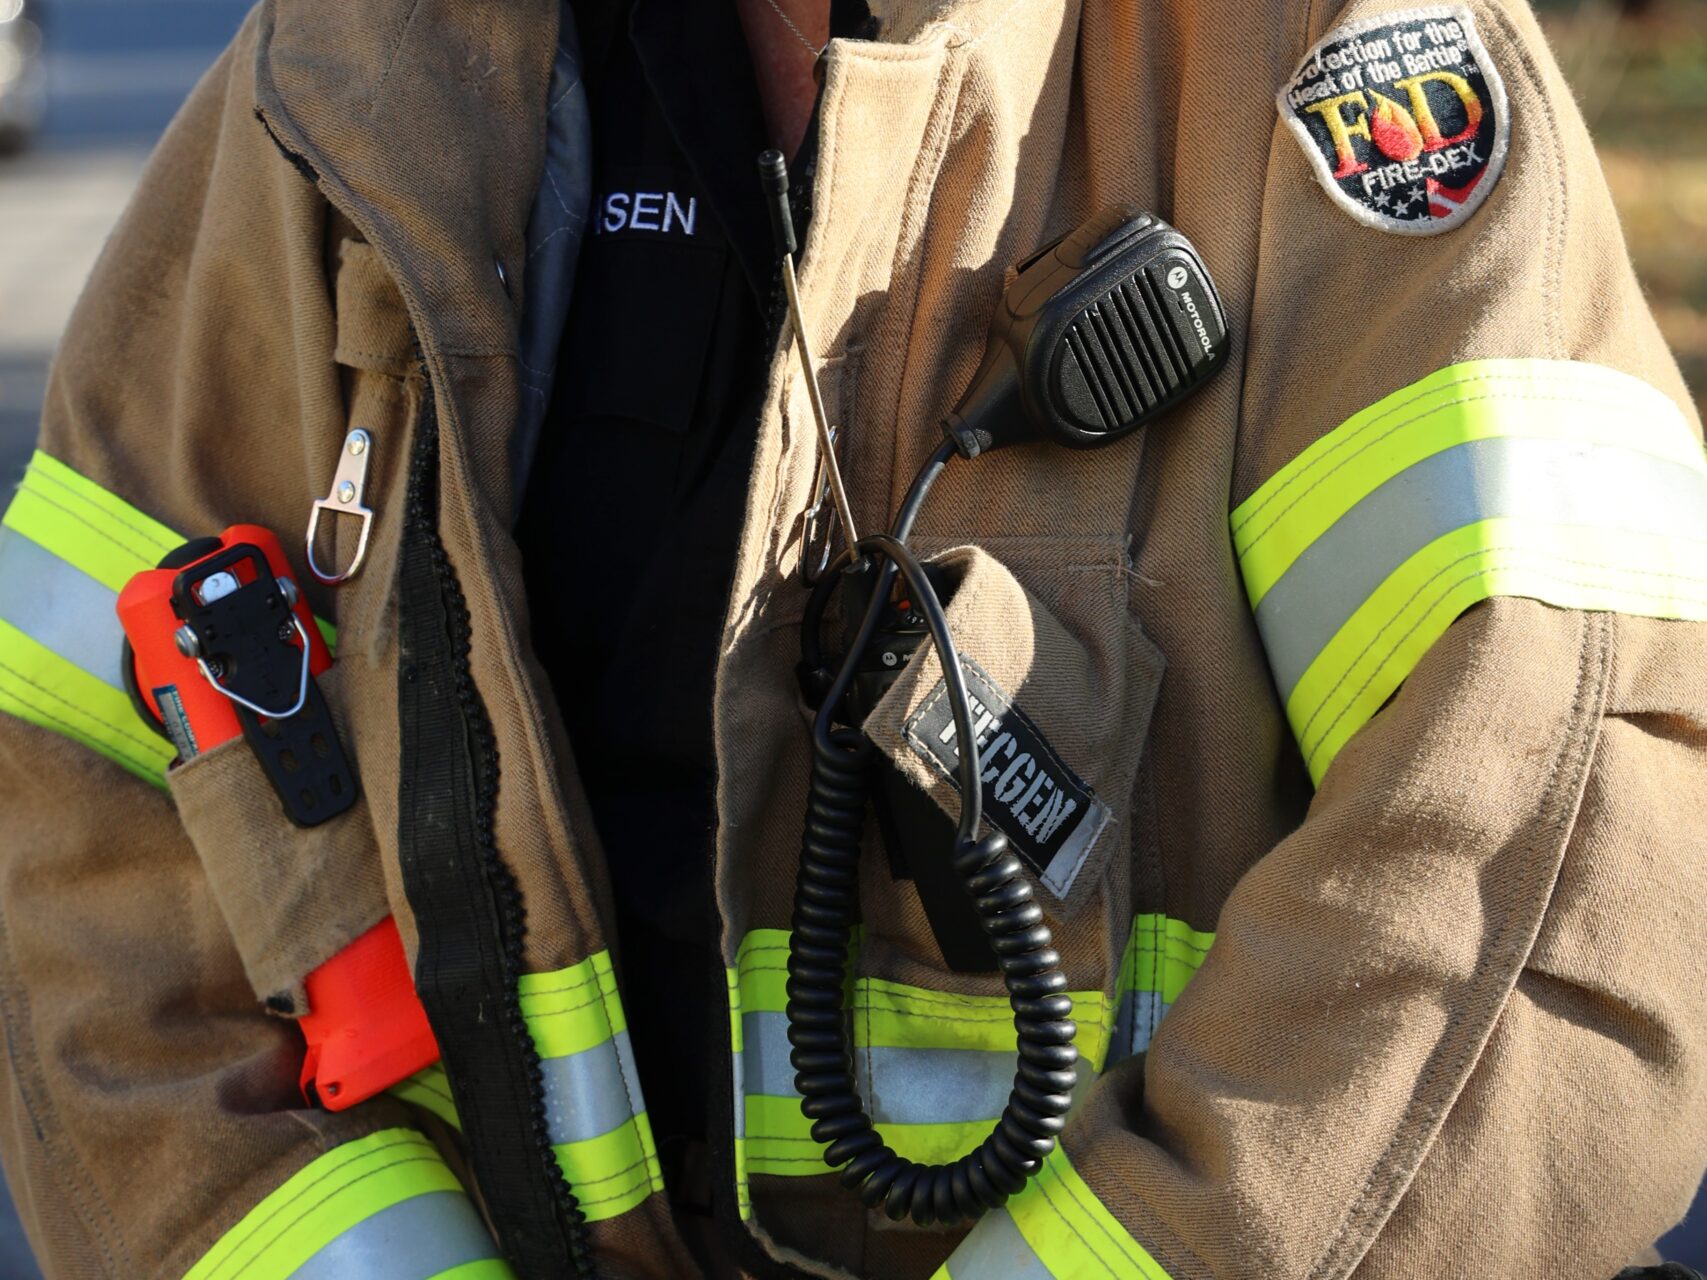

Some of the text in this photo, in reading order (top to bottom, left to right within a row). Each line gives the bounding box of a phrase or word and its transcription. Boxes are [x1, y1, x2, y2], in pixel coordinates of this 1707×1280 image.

[1392, 31, 1422, 54] for
[1424, 21, 1462, 45] the
[1288, 73, 1340, 109] Heat
[1341, 64, 1364, 90] of
[1367, 60, 1402, 84] the
[1361, 142, 1485, 197] FIRE-DEX
[597, 191, 697, 235] SEN
[1180, 291, 1217, 362] MOTOROLA
